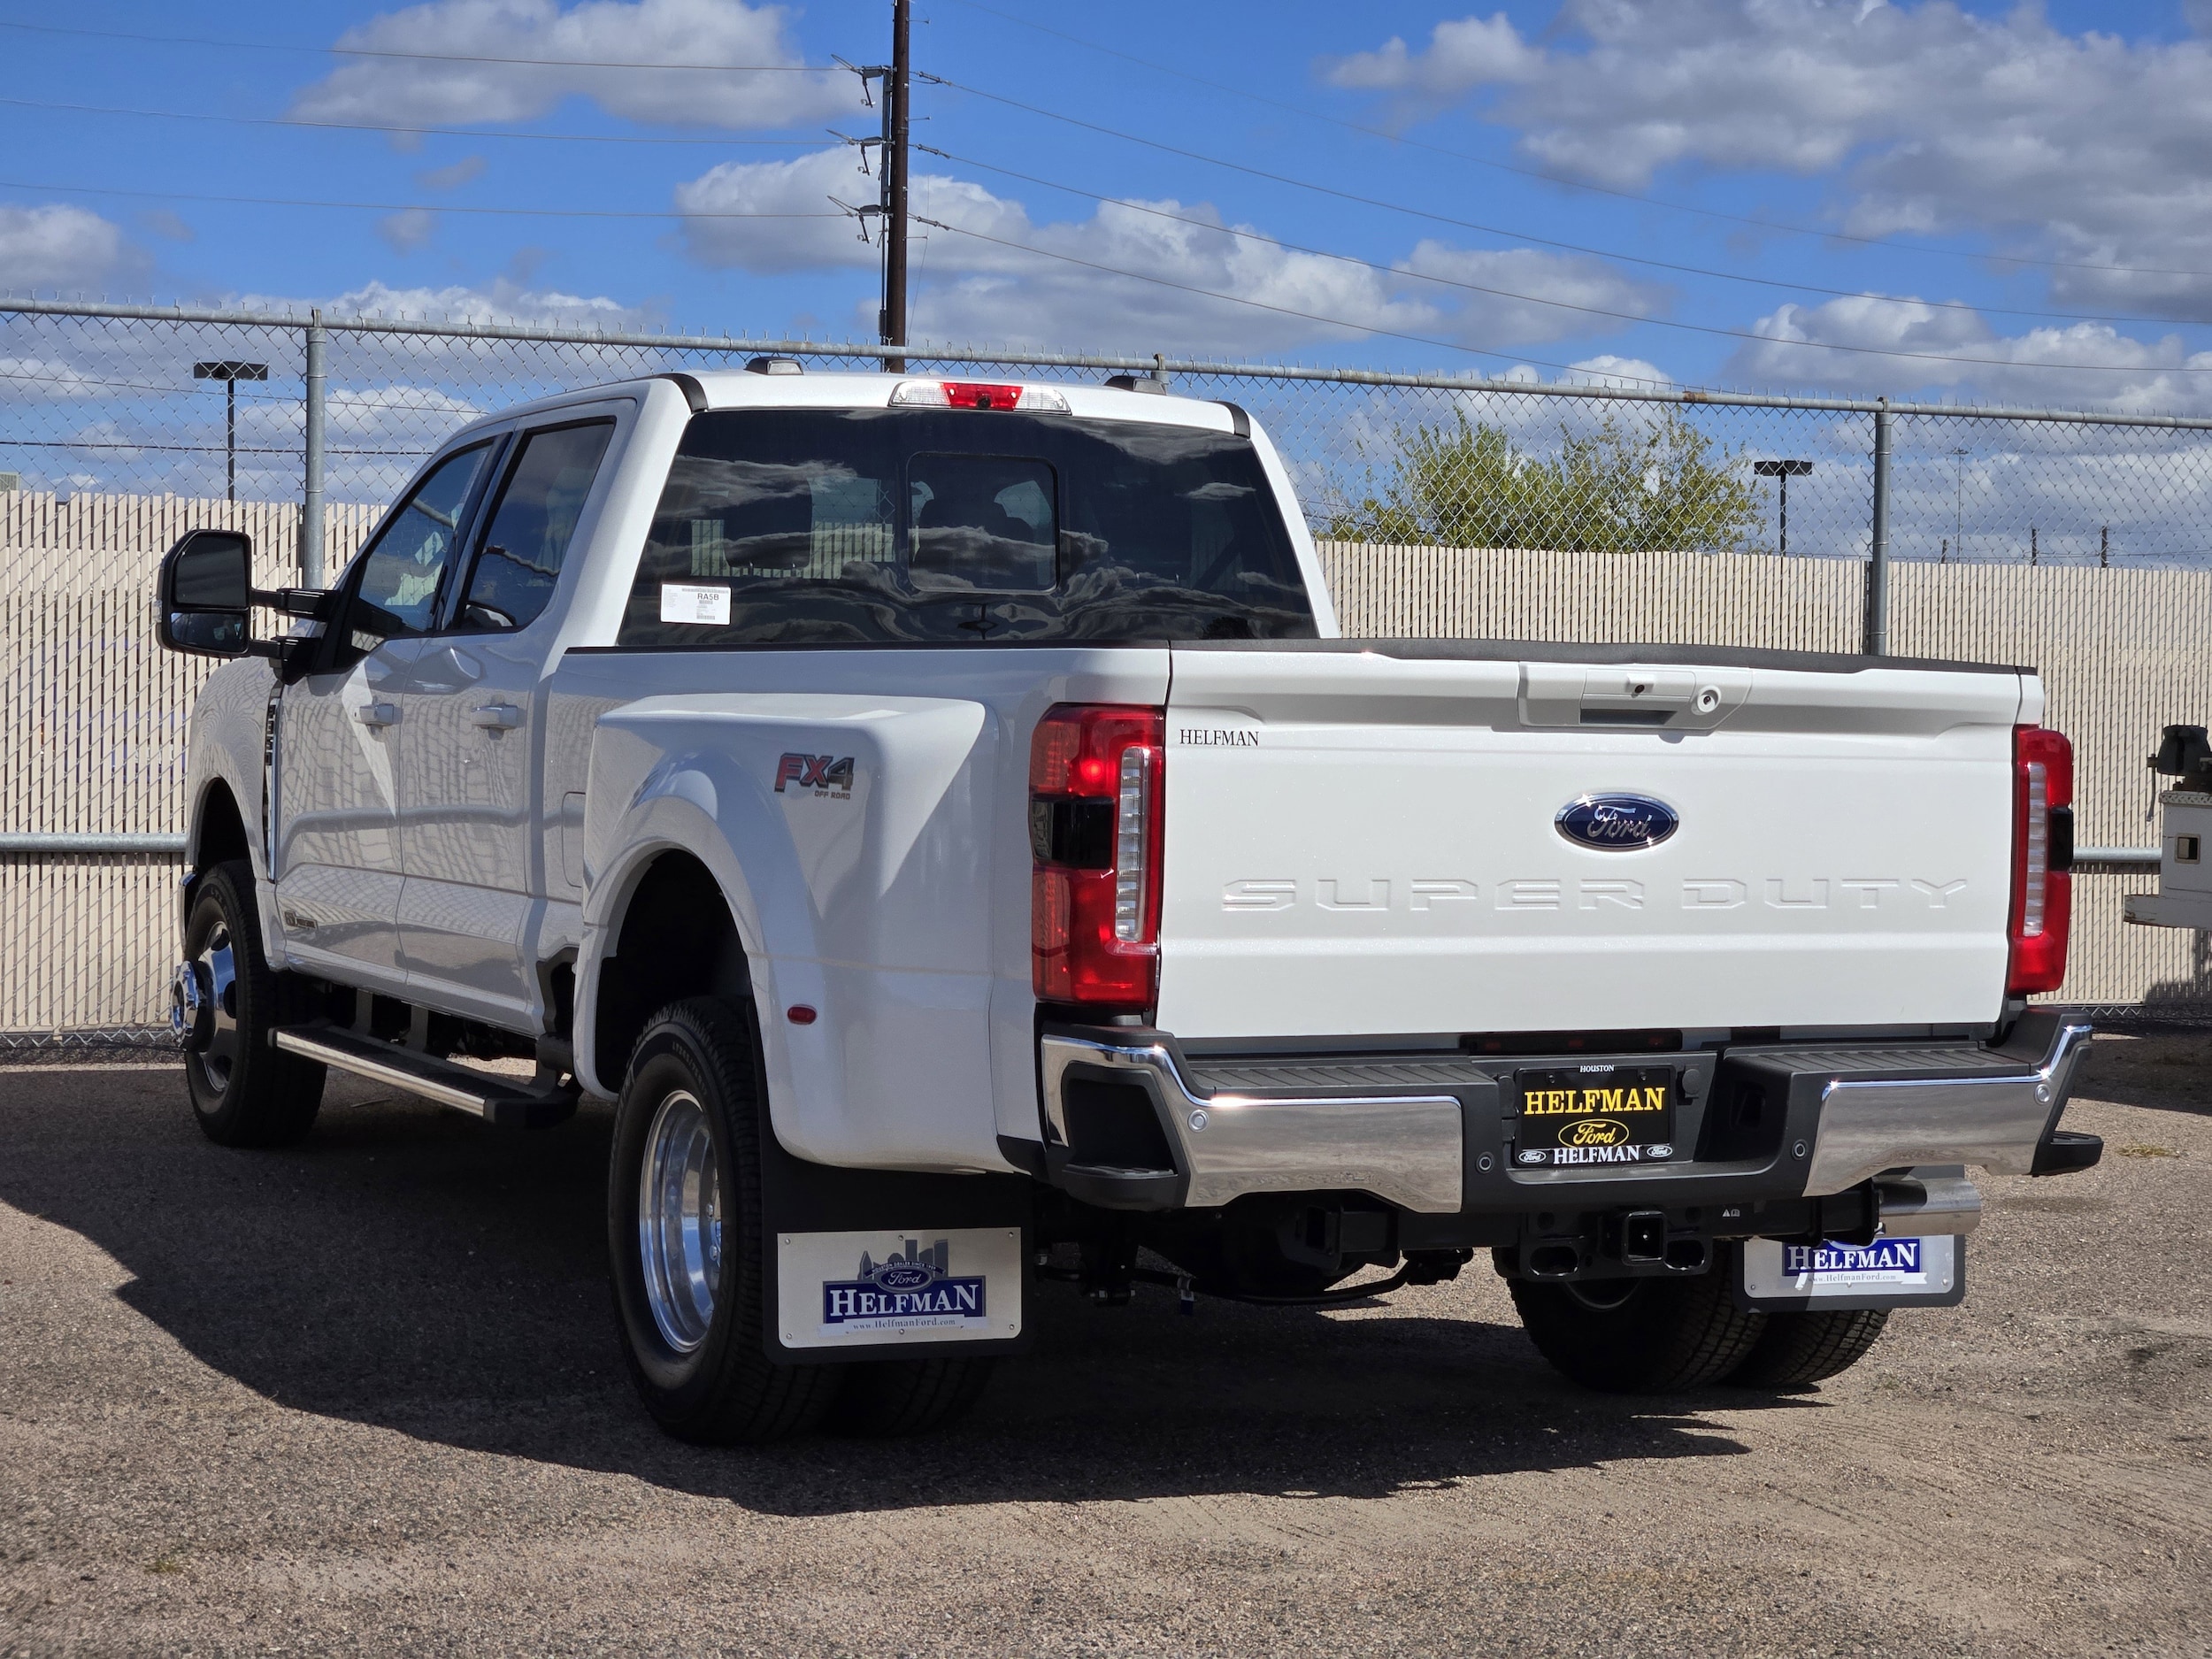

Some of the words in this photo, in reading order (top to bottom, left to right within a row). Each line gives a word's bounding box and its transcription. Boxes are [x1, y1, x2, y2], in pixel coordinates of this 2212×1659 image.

[1179, 729, 1259, 746] HELFMAN
[774, 753, 855, 793] FX4
[1586, 805, 1652, 838] Ford
[1222, 879, 1643, 910] SUPER
[1682, 879, 1967, 909] DUTY
[1524, 1087, 1666, 1115] HELFMAN
[1572, 1122, 1617, 1145] Ford
[1553, 1145, 1642, 1164] HELFMAN
[1788, 1243, 1917, 1270] HELFMAN
[887, 1271, 922, 1286] Ford
[1808, 1272, 1897, 1283] www.HelfmanFord.com
[830, 1285, 979, 1317] HELFMAN
[853, 1317, 956, 1330] www.HelfmanFord.com
